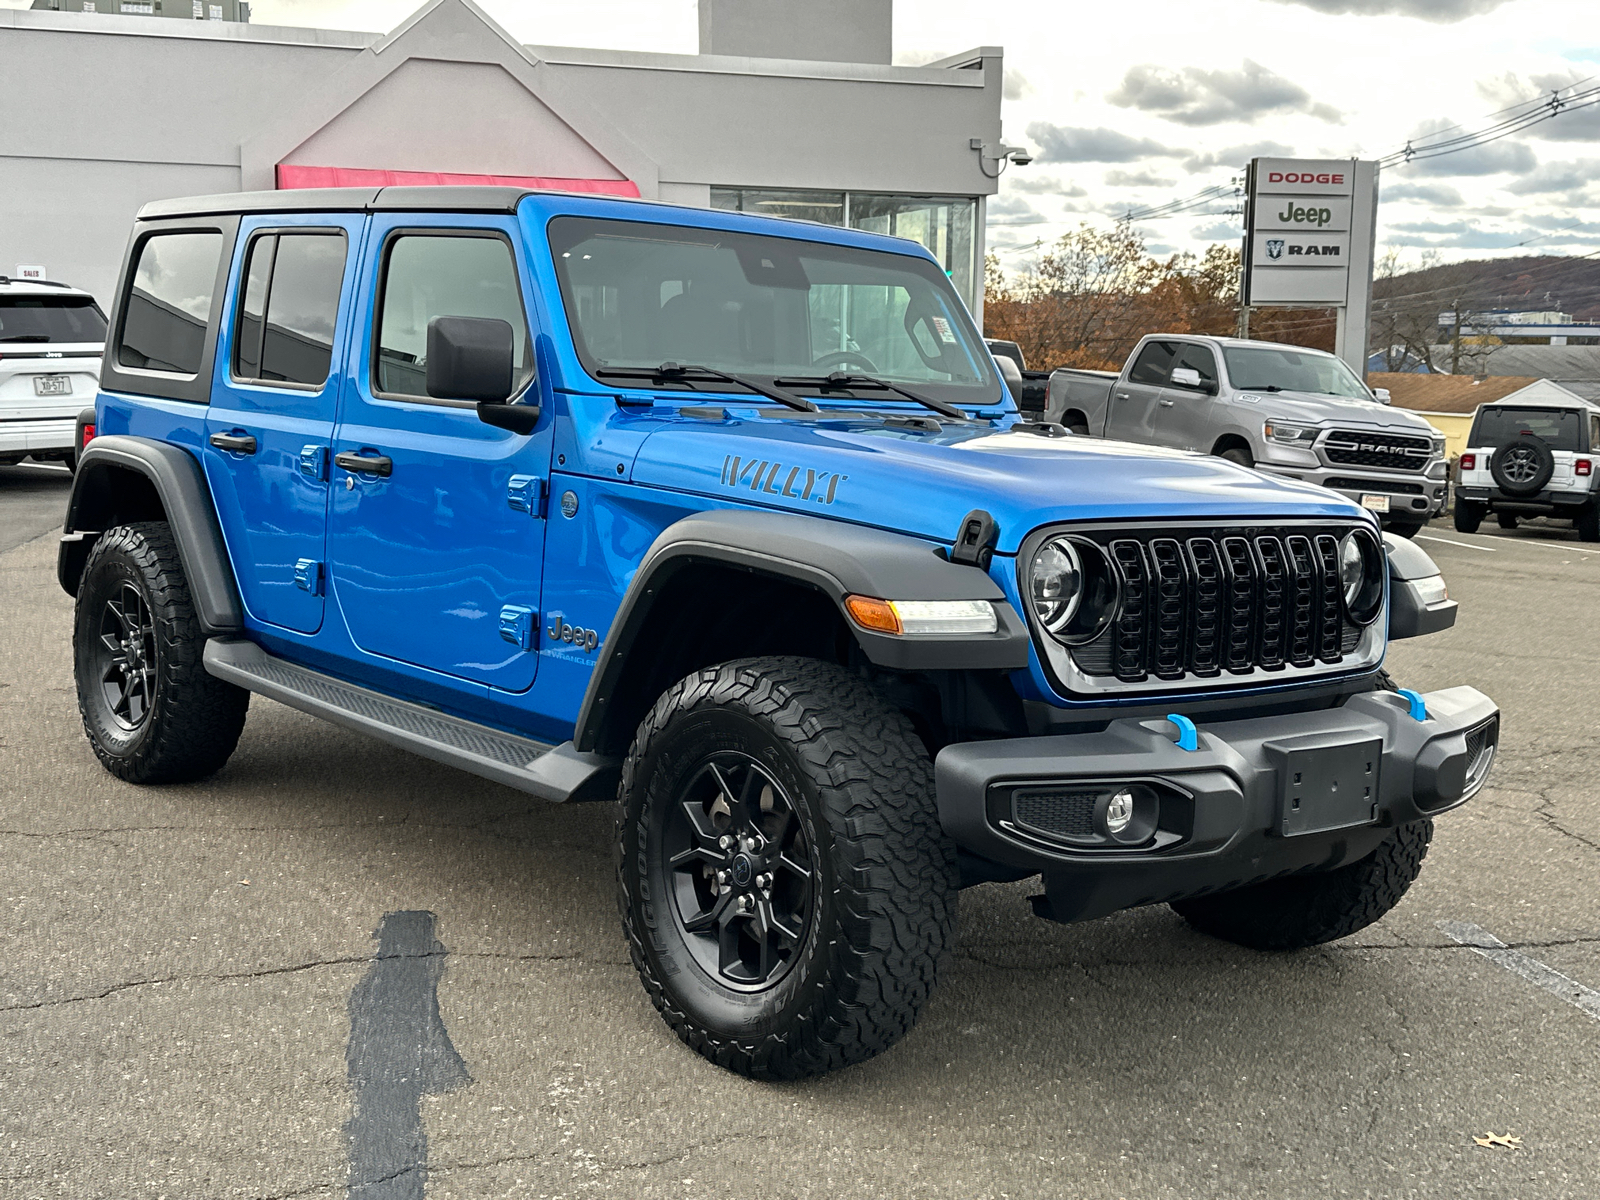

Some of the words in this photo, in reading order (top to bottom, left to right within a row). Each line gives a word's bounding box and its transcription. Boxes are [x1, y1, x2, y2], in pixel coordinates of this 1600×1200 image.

[1268, 172, 1344, 184] DODGE
[1278, 201, 1331, 227] Jeep
[1288, 245, 1340, 255] RAM
[1360, 444, 1404, 454] RAM
[720, 454, 849, 505] WILLYS
[547, 616, 598, 653] Jeep
[551, 650, 597, 666] WRANGLER
